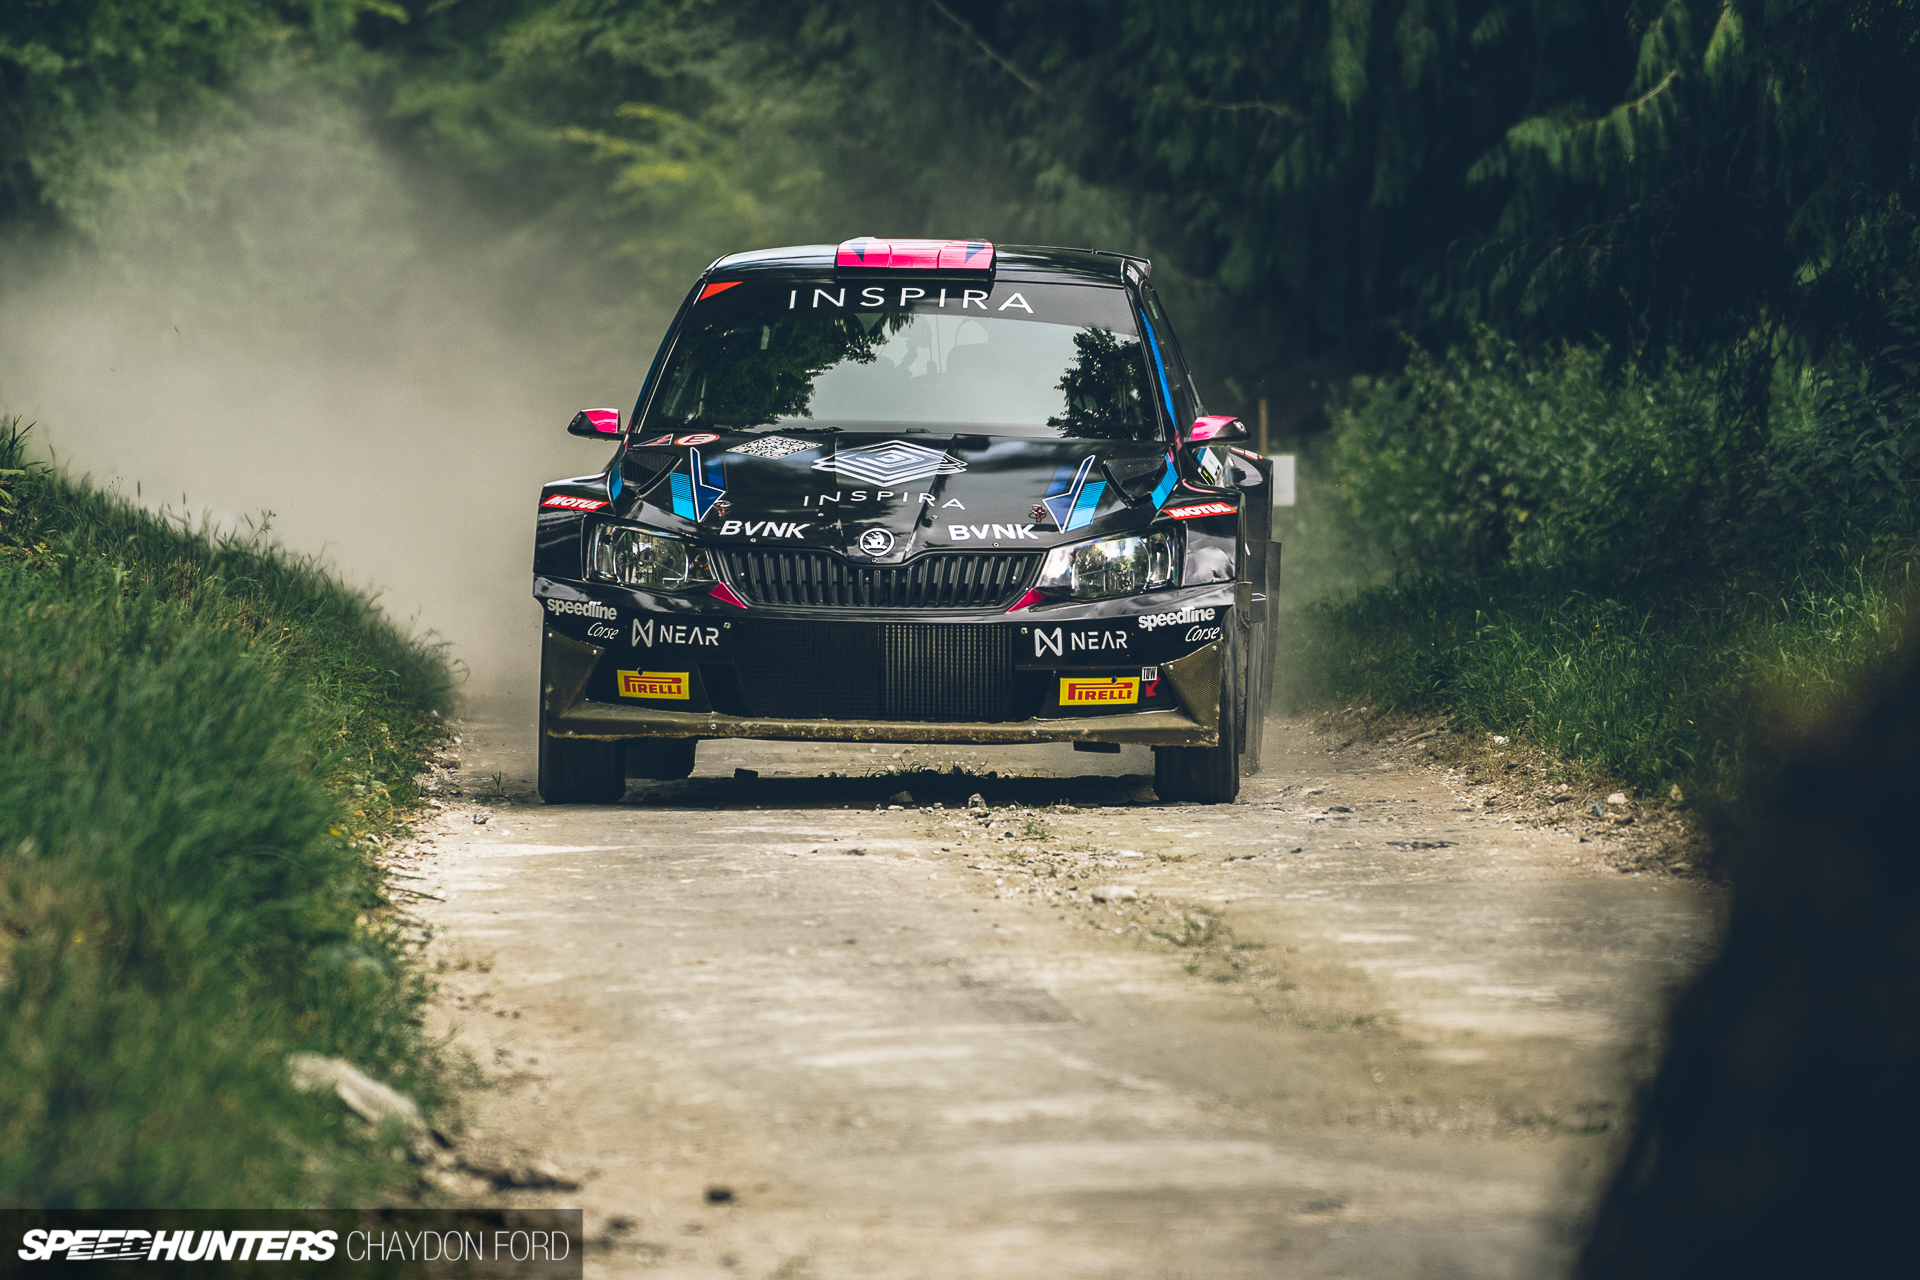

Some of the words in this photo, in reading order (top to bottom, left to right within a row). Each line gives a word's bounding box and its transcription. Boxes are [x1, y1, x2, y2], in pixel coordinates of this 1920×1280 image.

[789, 287, 1035, 314] INSPIRA
[544, 496, 603, 510] MOTUL
[803, 490, 966, 511] INSPIRA
[1169, 503, 1232, 518] MOTUL
[719, 520, 811, 540] BVNK
[947, 523, 1039, 541] BVNK
[547, 598, 617, 621] speedline
[1138, 605, 1216, 631] speedline
[587, 621, 620, 640] Corse
[659, 624, 720, 646] NEAR
[1071, 630, 1128, 651] NEAR
[1185, 624, 1221, 642] Corse
[1142, 667, 1157, 680] TOW
[623, 674, 682, 695] PIRELLI
[1067, 682, 1134, 701] PIRELLI
